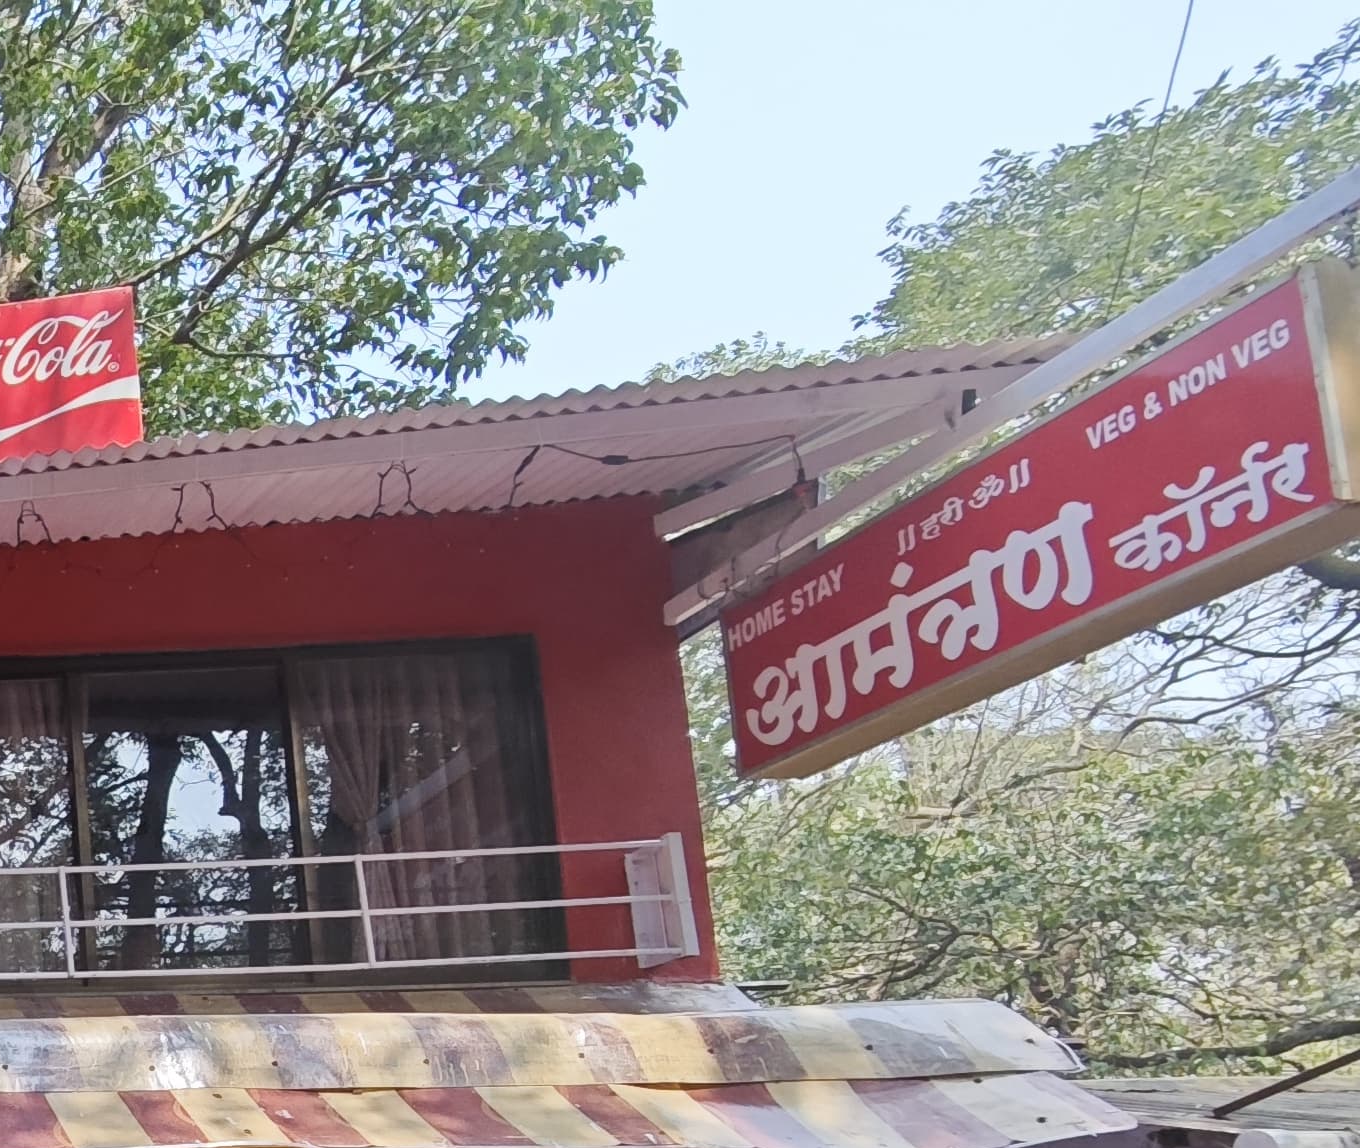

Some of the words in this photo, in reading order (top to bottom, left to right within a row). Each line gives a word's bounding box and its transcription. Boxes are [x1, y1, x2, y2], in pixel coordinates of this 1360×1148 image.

[1085, 405, 1138, 451] VEG
[1142, 390, 1165, 420] &
[1167, 358, 1227, 410] NON
[1231, 318, 1291, 371] VEG
[920, 497, 965, 540] हरी
[968, 474, 1005, 509] ॐ
[727, 598, 785, 653] HOME
[790, 563, 846, 617] STAY
[745, 500, 1097, 746] आमंत्रण
[1108, 439, 1315, 572] कॉर्नर
